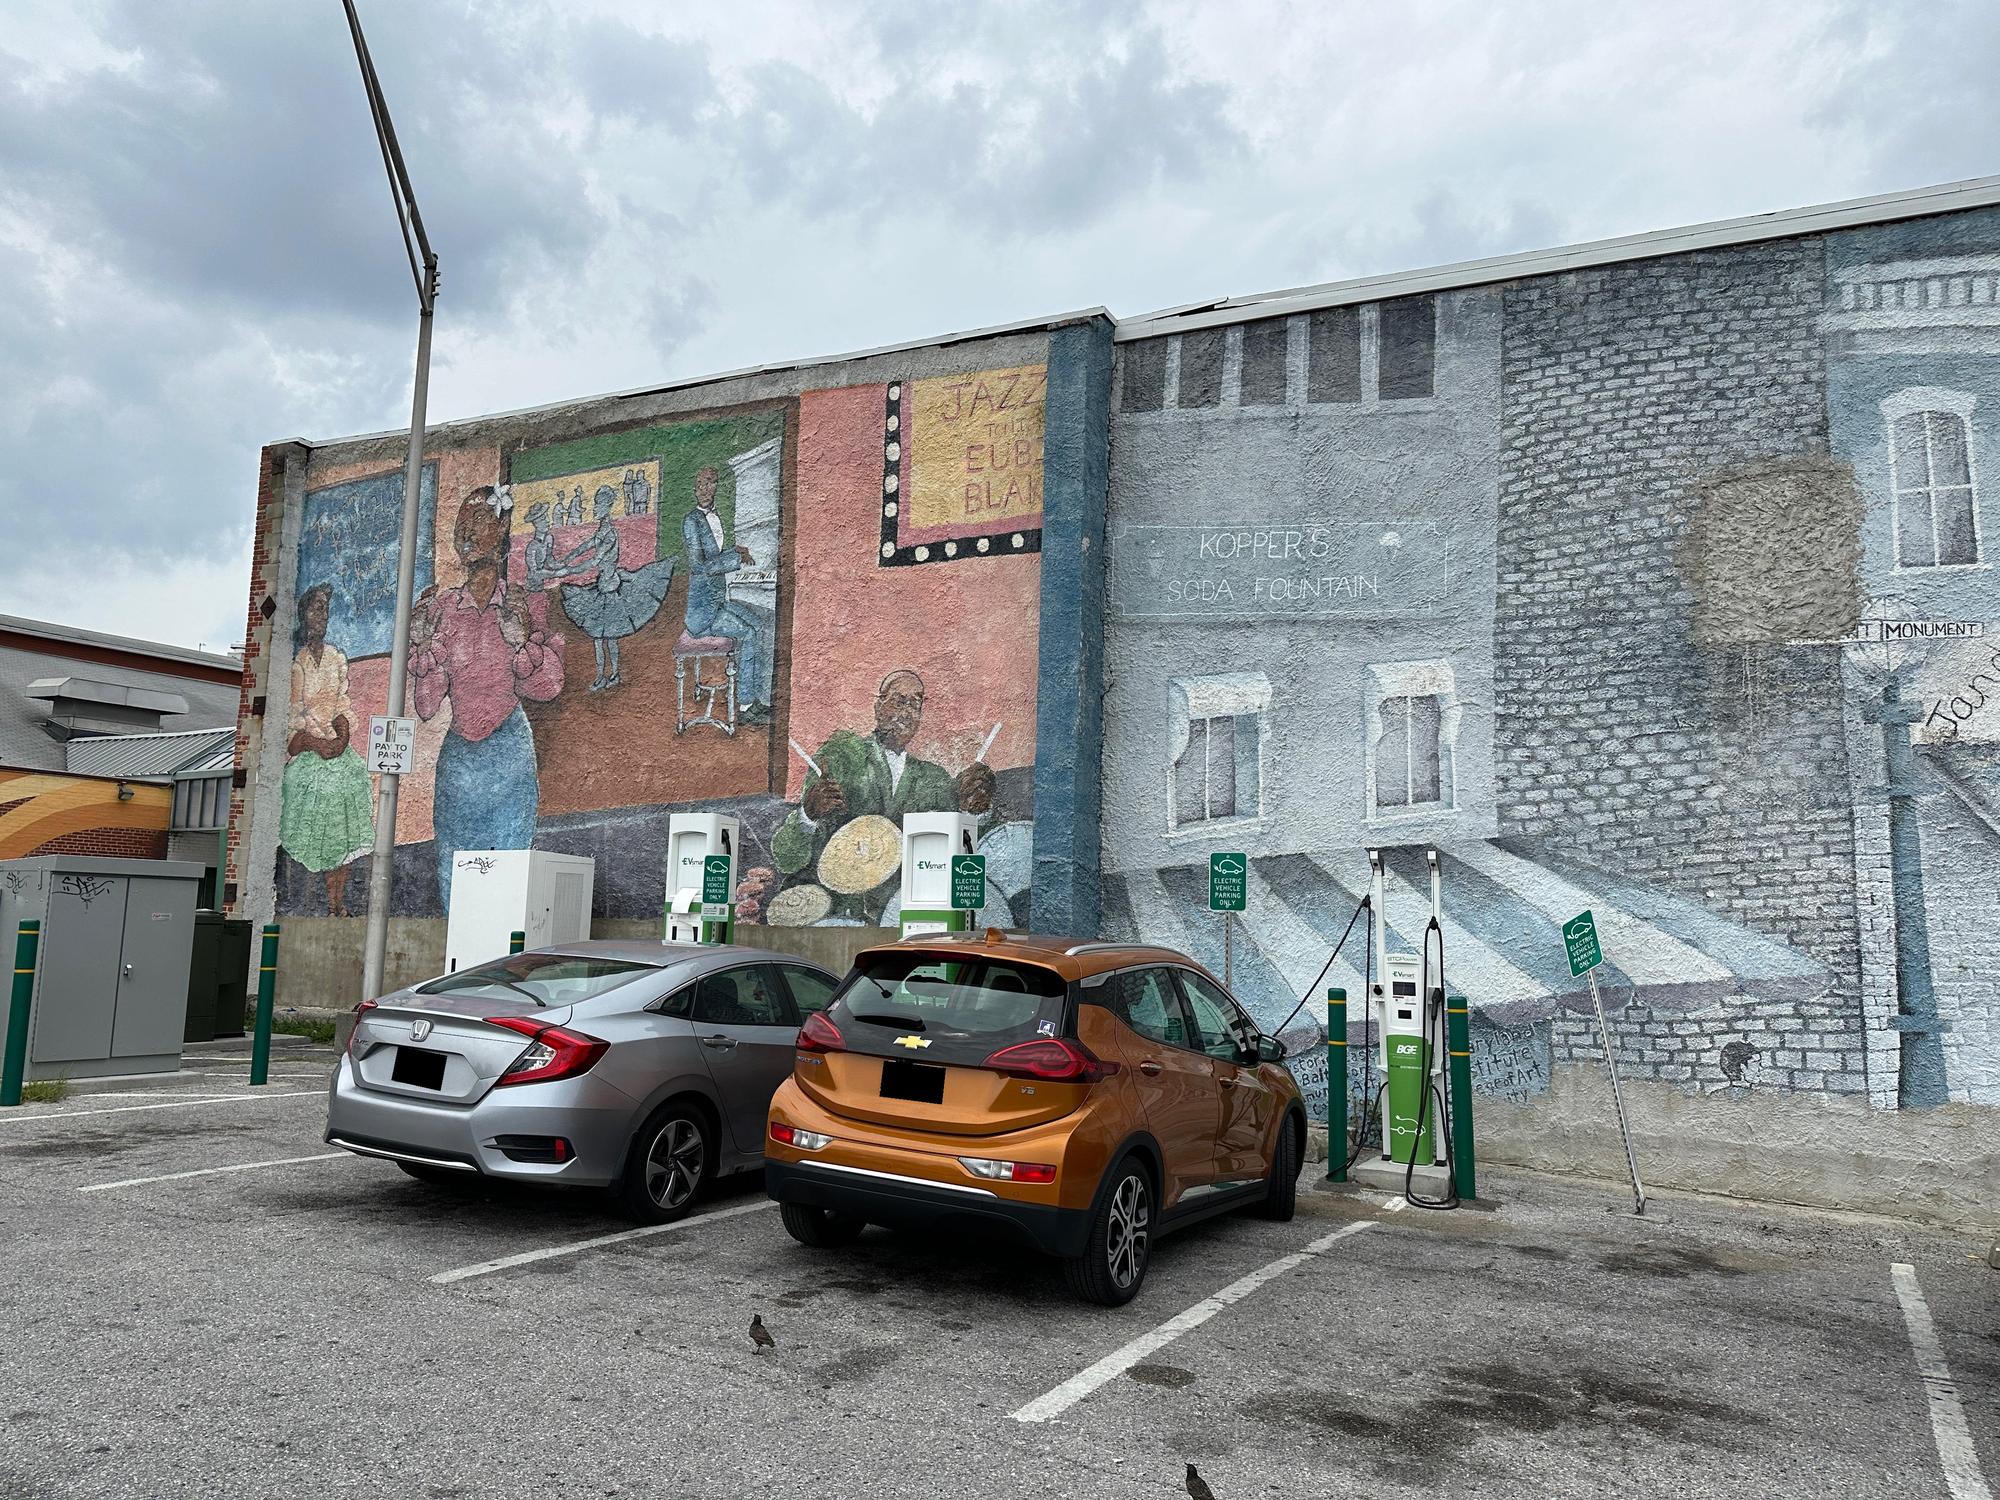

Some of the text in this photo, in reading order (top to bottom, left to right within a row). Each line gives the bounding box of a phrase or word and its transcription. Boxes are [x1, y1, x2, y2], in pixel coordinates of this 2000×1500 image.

[941, 371, 1047, 421] JAZZ
[1167, 575, 1378, 601] SODA FOUNTAIN
[1885, 622, 1976, 639] MONUMENT
[375, 743, 407, 752] PAY TO
[1570, 934, 1593, 952] ELECTRIC
[1396, 1044, 1418, 1055] BGE
[1517, 1060, 1542, 1085] Art
